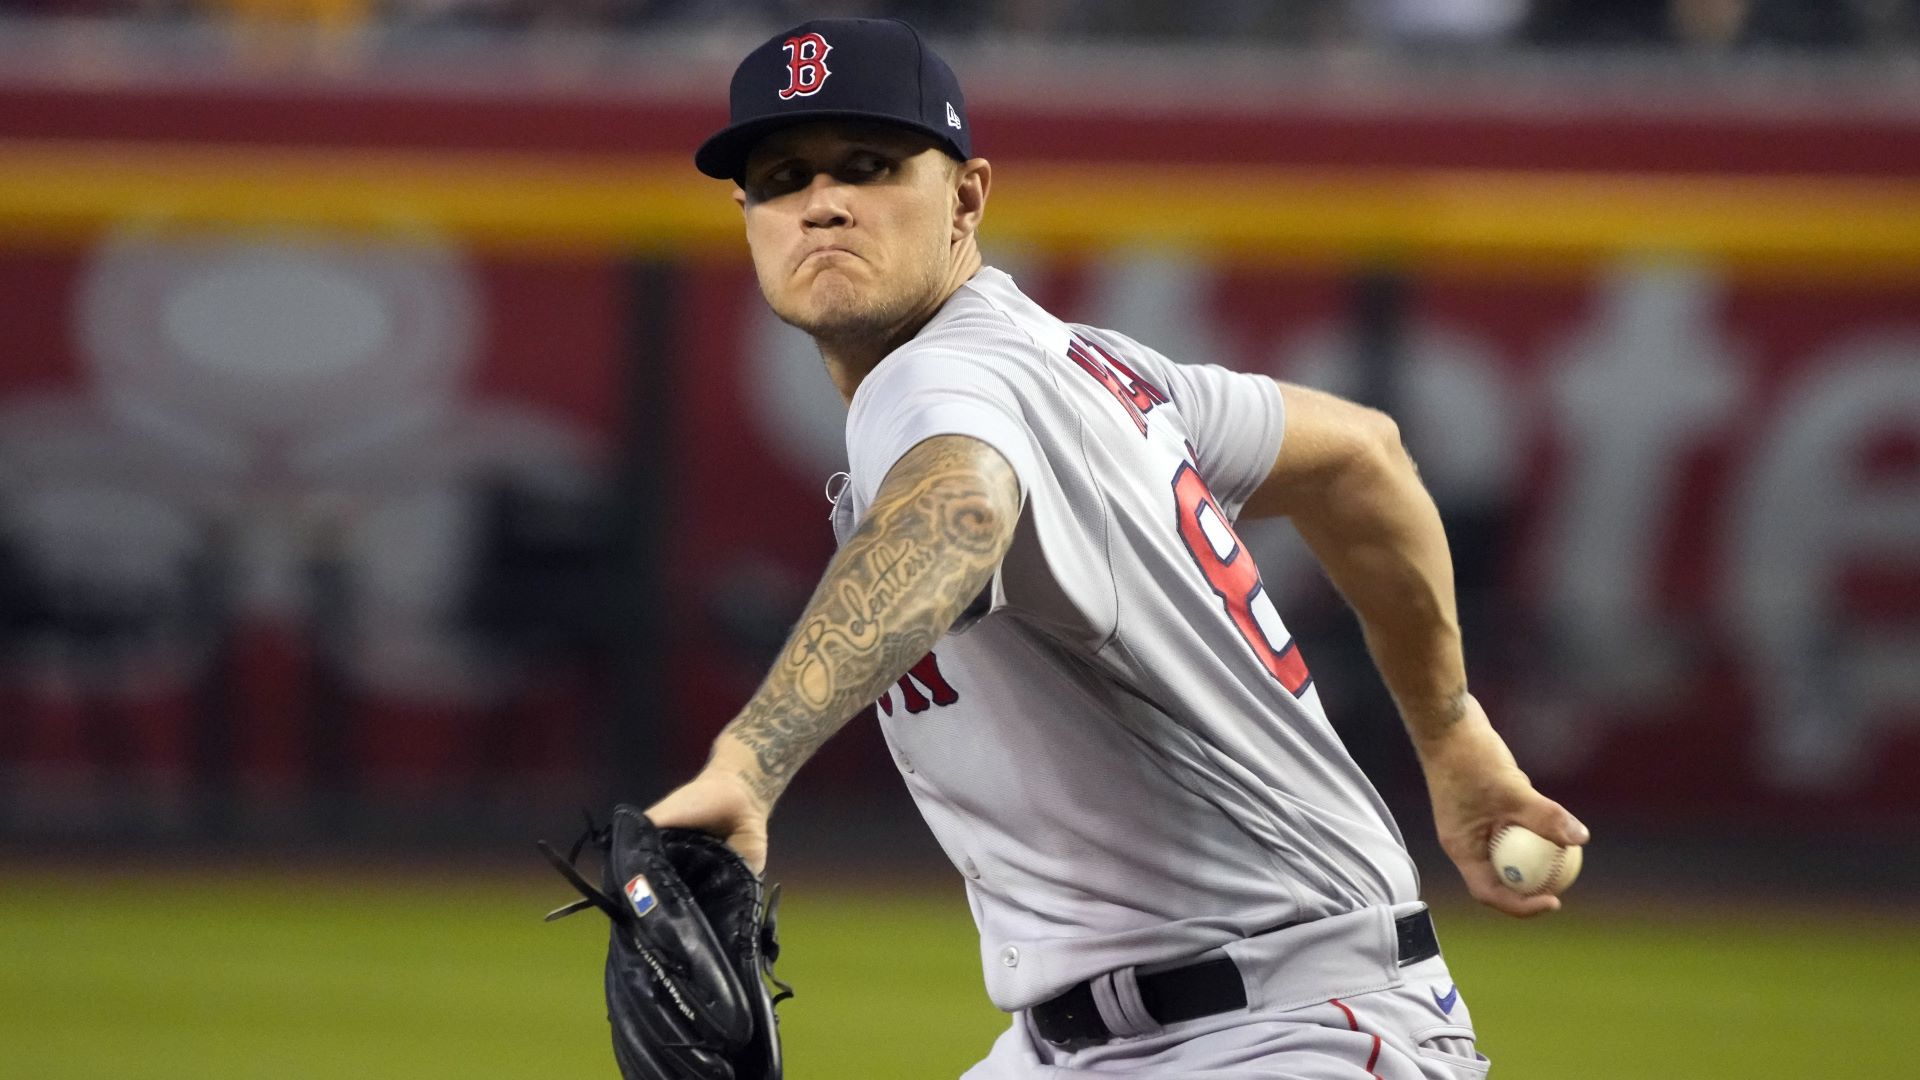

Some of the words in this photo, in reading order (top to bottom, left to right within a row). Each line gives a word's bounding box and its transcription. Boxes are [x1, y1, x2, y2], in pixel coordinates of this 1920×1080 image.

[779, 33, 833, 100] B
[790, 540, 933, 705] Relentless
[1172, 438, 1314, 699] 8
